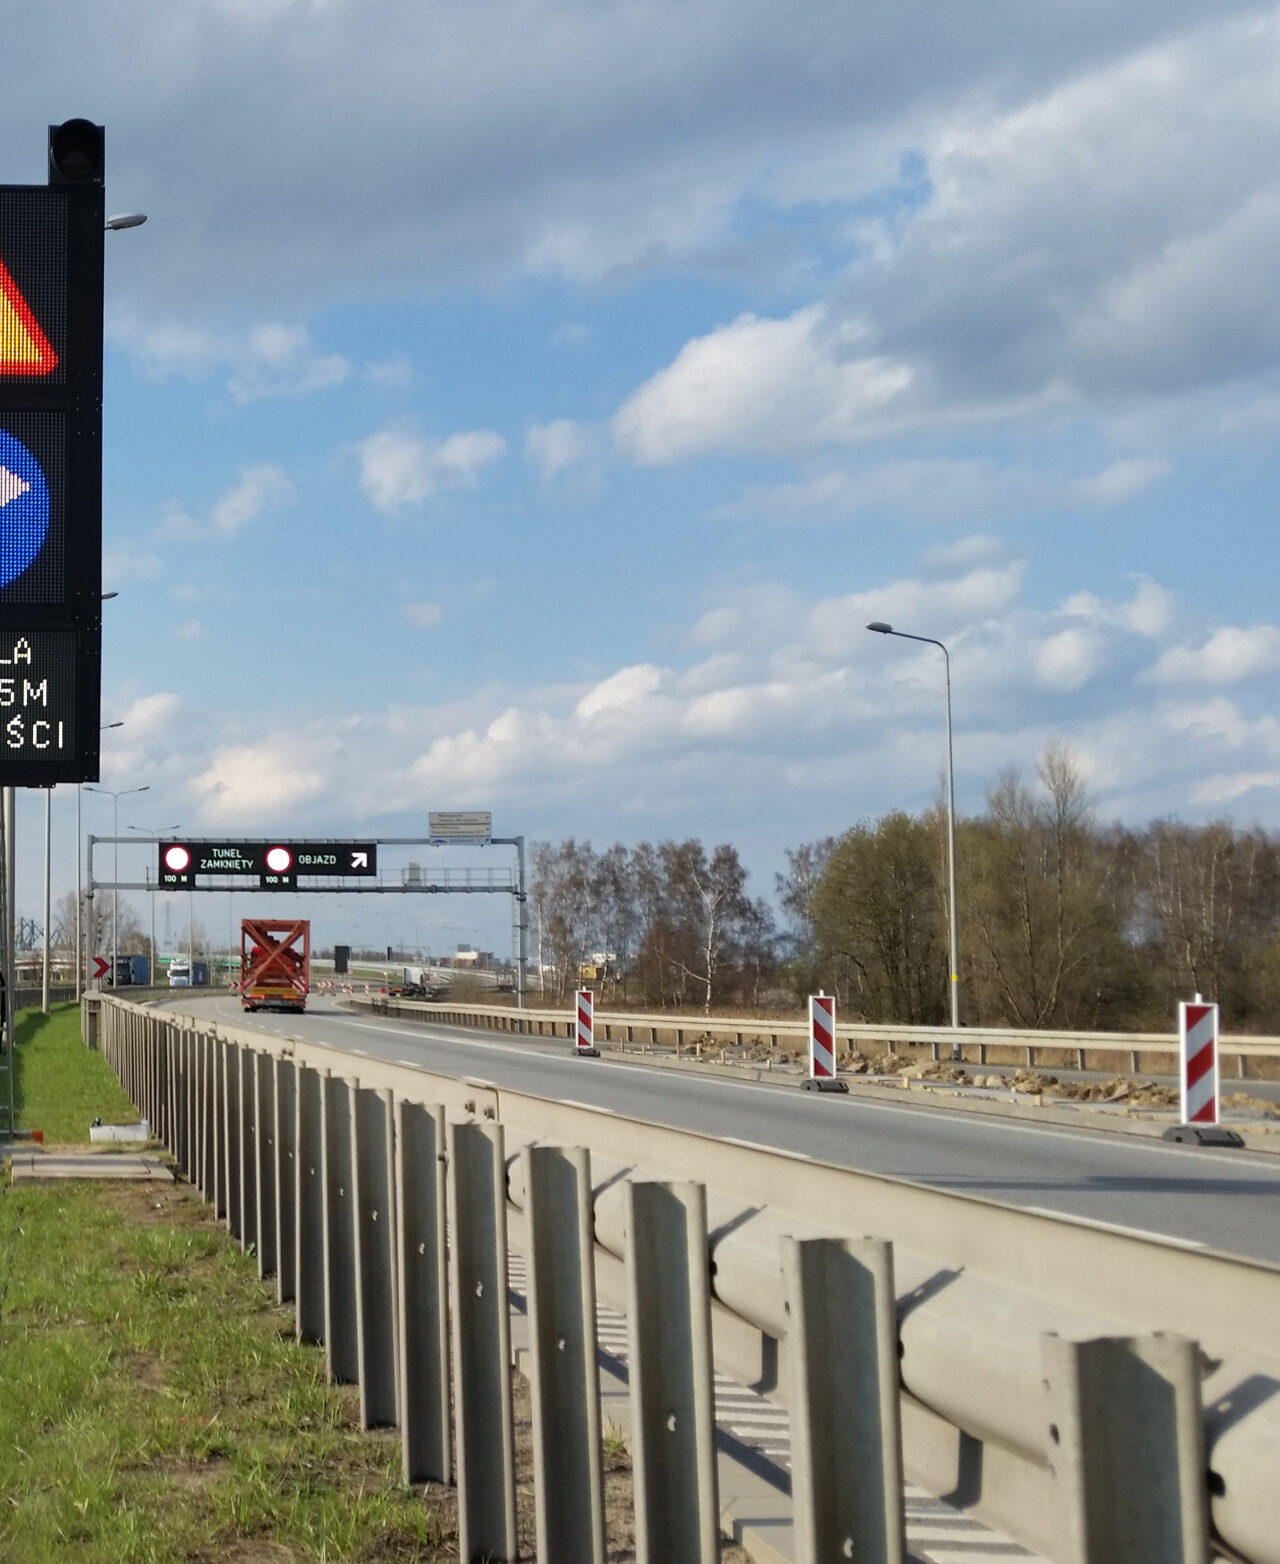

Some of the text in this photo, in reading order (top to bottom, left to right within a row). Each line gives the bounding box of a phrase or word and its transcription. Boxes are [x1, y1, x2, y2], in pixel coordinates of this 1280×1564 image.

[212, 848, 242, 859] TUNEL
[200, 859, 254, 870] ZAMKNIĘTY
[298, 854, 337, 865] OBJAZD
[164, 874, 188, 883] 100 M
[265, 875, 290, 884] 100 M
